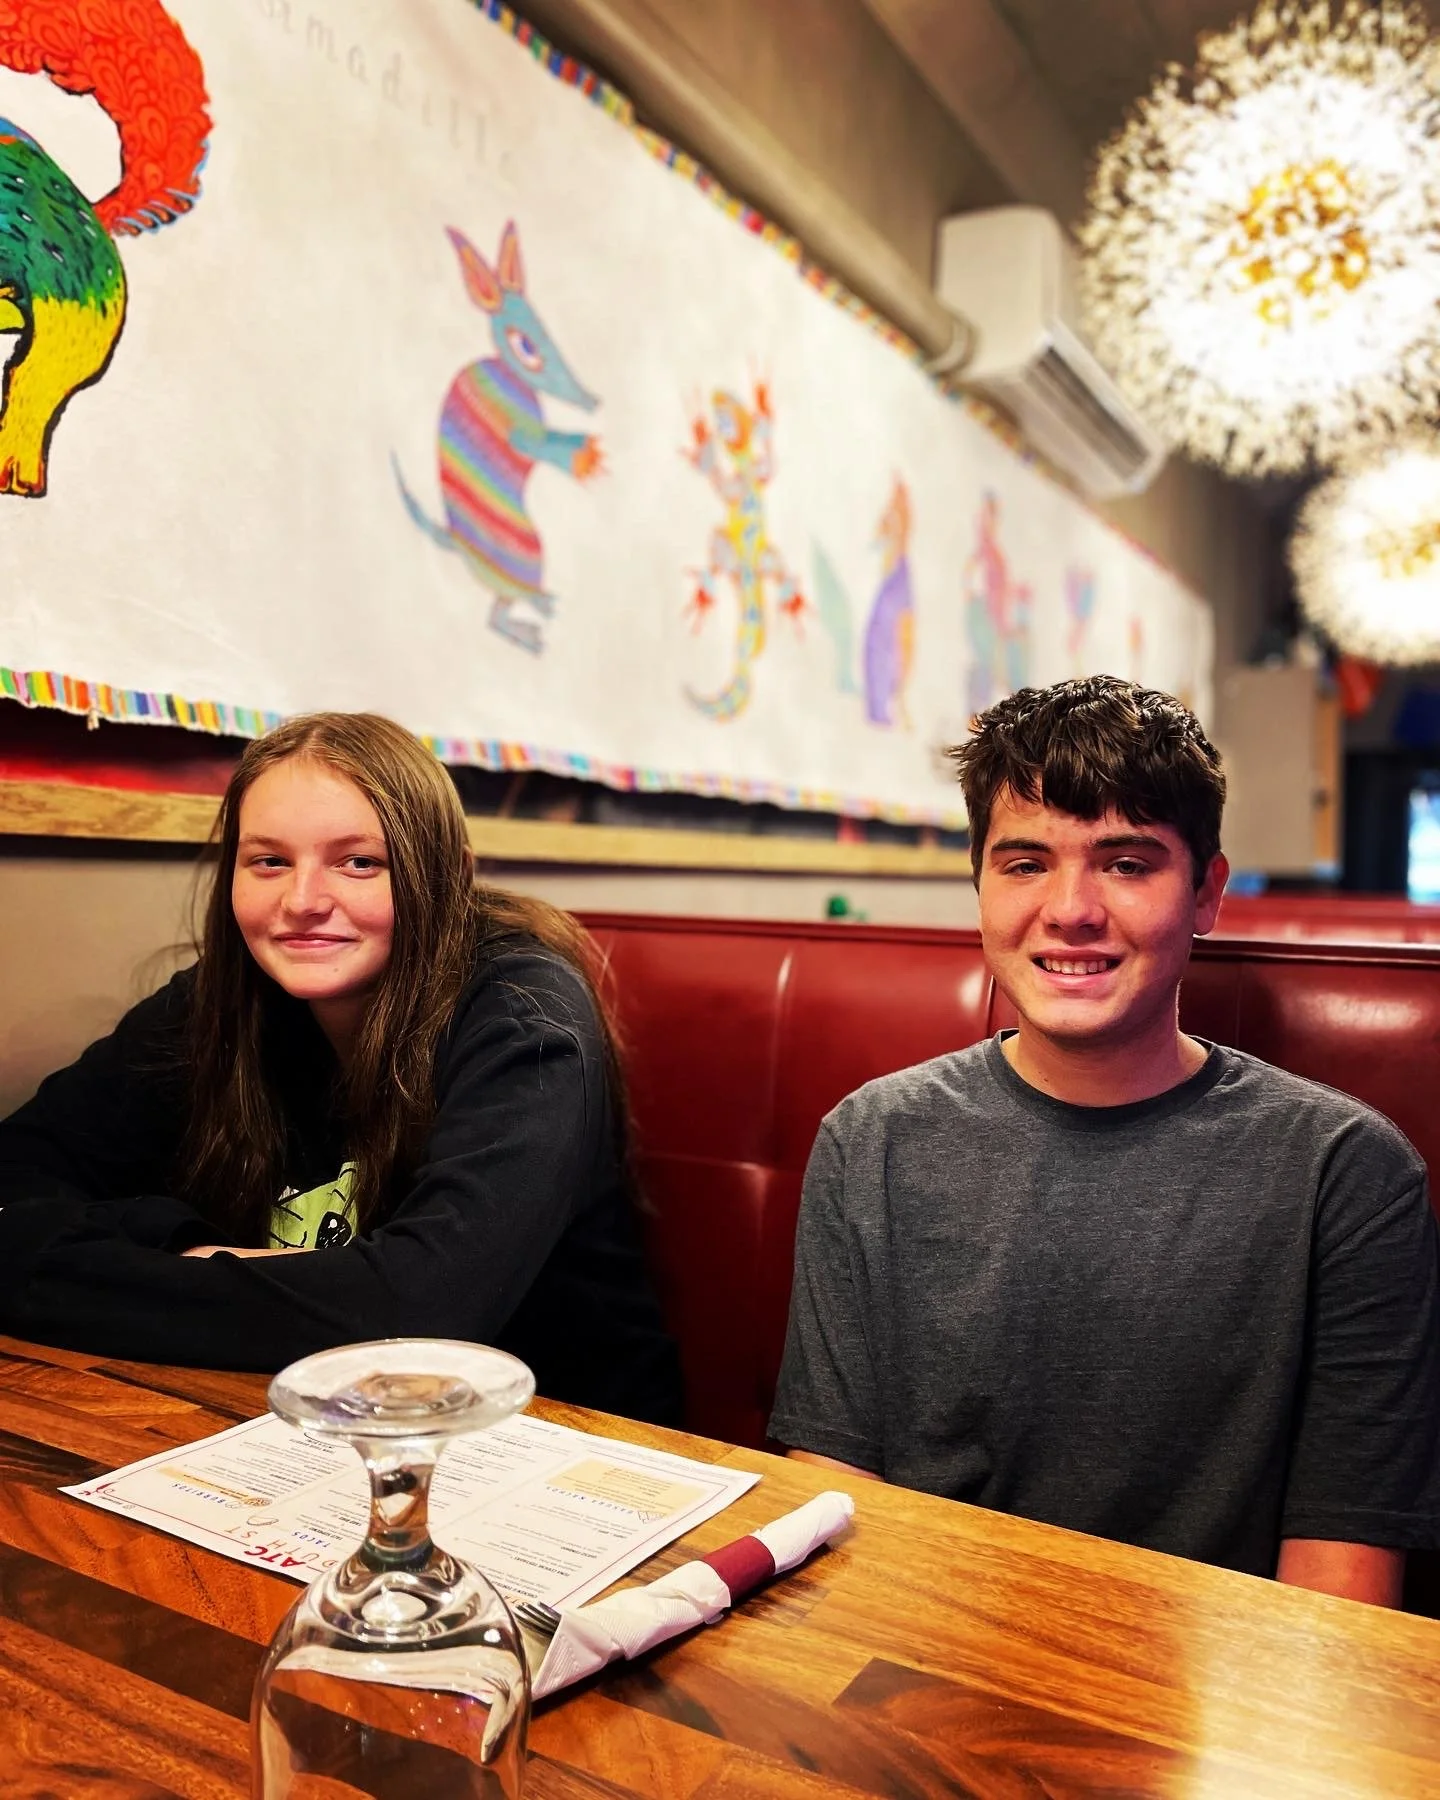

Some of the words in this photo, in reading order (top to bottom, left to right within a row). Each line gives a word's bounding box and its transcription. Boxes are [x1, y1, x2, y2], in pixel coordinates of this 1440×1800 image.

[171, 1483, 226, 1504] BURRITOS
[224, 1526, 258, 1538] ST
[292, 1531, 331, 1548] TACOS
[244, 1546, 306, 1567] ATC
